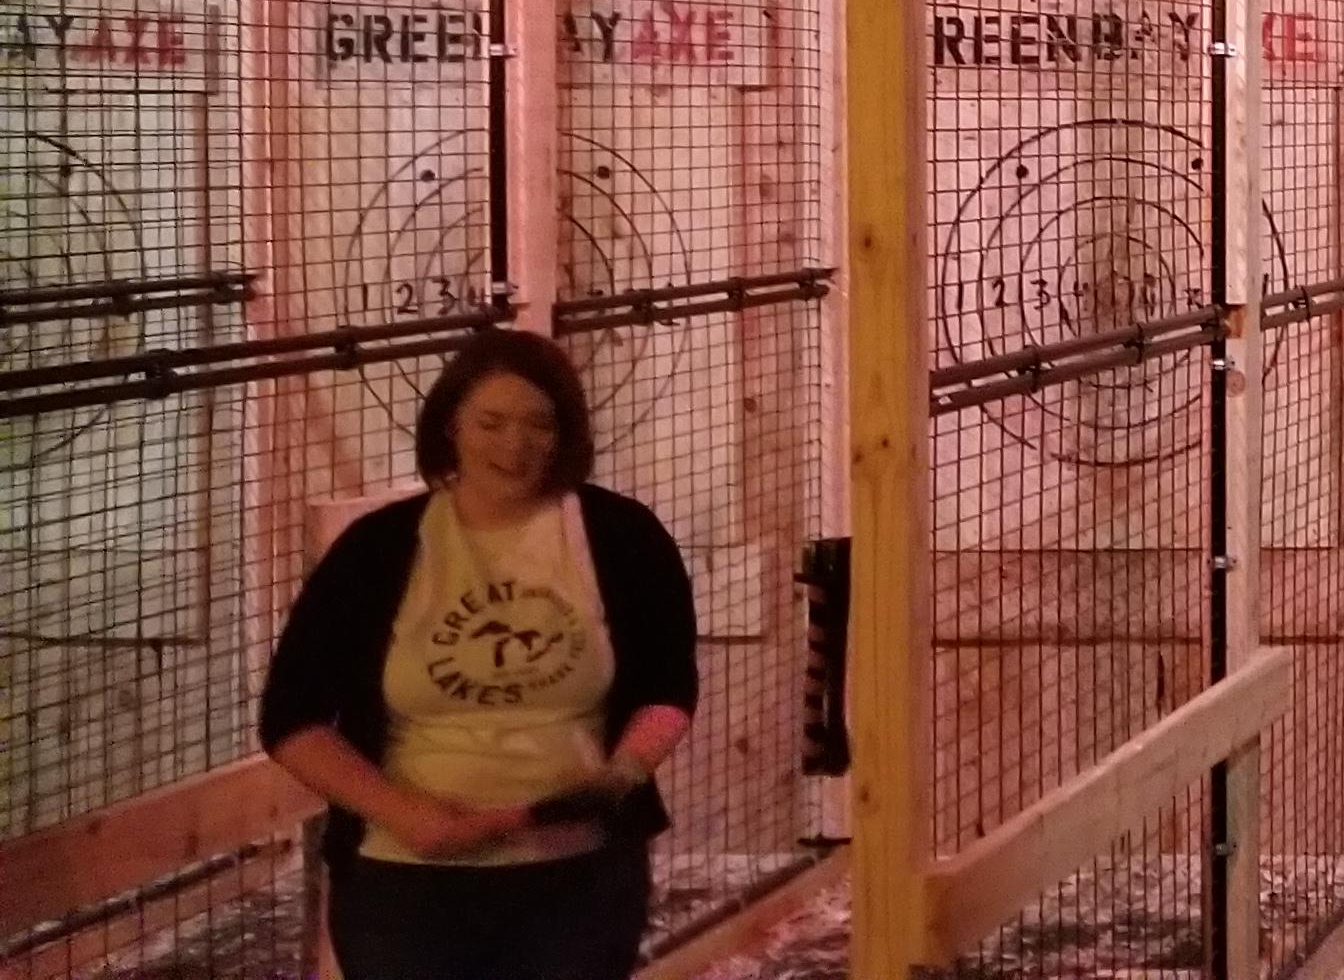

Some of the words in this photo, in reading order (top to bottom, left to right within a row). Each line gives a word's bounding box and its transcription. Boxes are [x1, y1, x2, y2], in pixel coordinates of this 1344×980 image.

[326, 12, 483, 63] GREE
[632, 2, 735, 62] AXE
[933, 11, 1077, 65] REEN
[396, 283, 418, 314] 2
[432, 580, 517, 646] GREAT
[427, 656, 523, 706] LAKES
